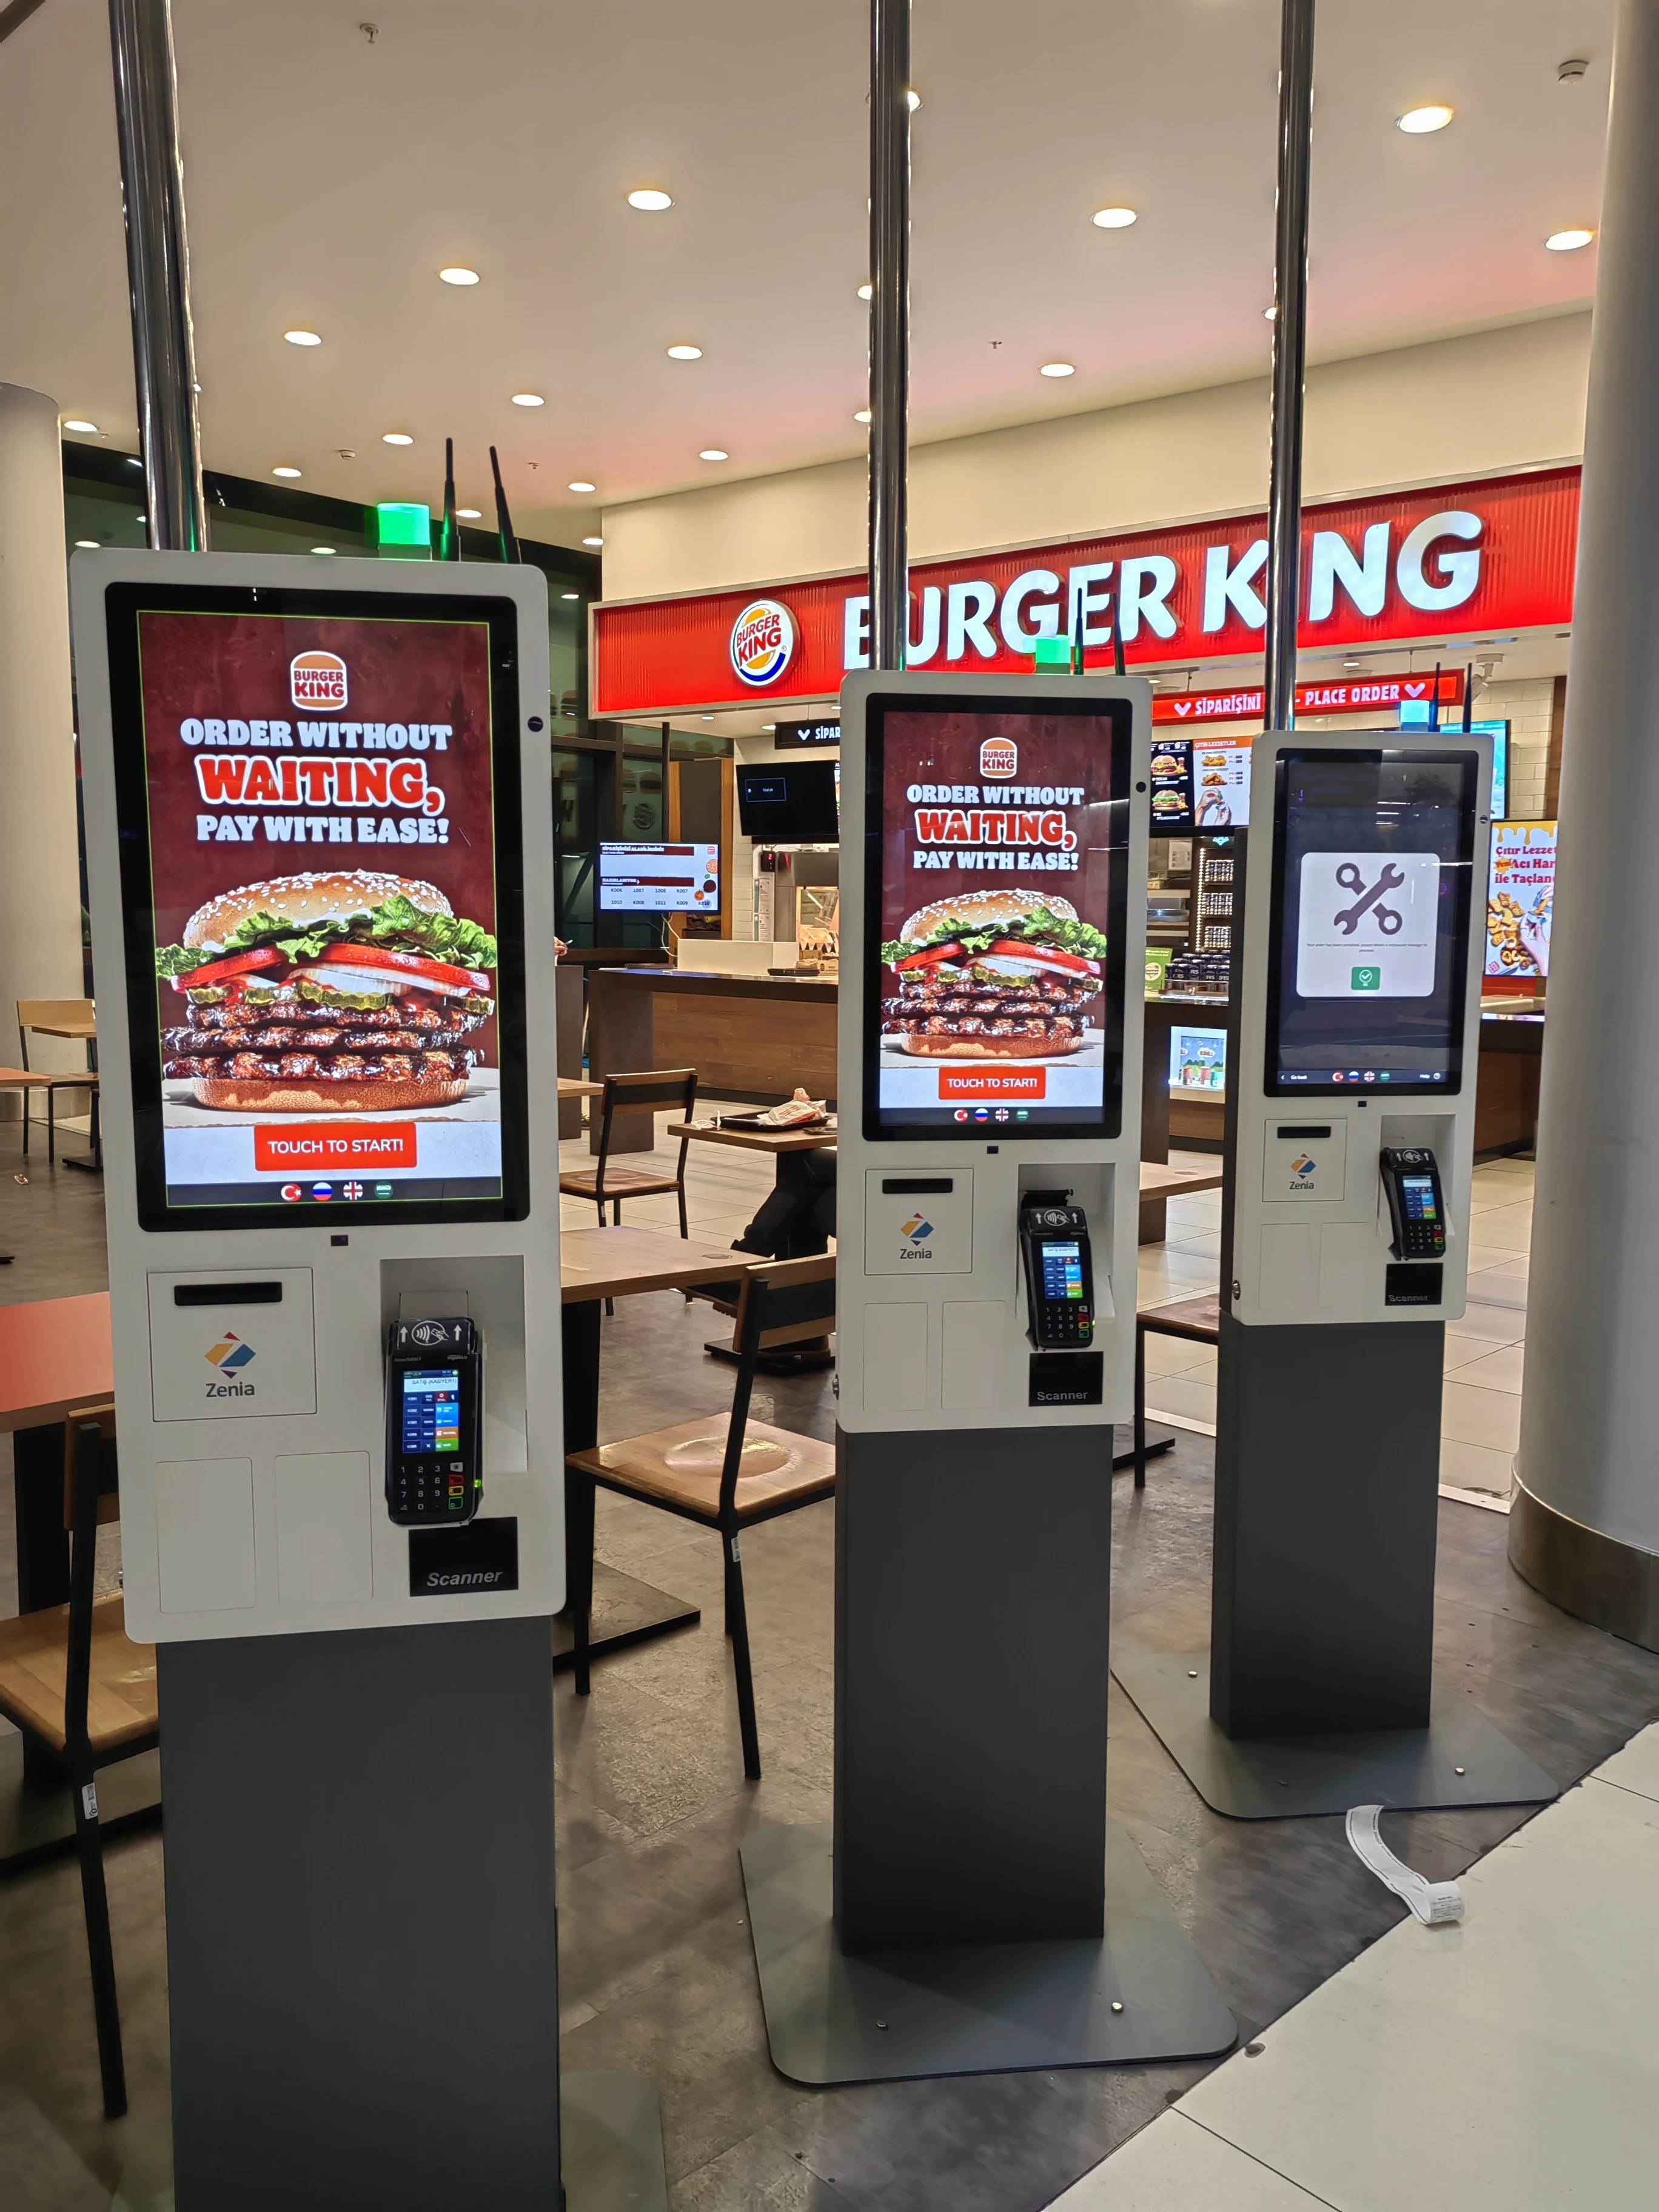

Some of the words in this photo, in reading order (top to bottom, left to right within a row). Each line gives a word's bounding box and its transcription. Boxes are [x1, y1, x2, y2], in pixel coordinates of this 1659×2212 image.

[1203, 511, 1482, 632] KNG
[737, 614, 780, 648] BURGER
[739, 627, 781, 667] KING
[293, 671, 344, 682] BURGER
[294, 682, 344, 698] KING
[1195, 692, 1261, 716] SİPARİŞİNİ
[1305, 688, 1346, 706] PLACE
[1353, 685, 1399, 702] ORDER
[181, 719, 293, 747] ORDER
[298, 721, 452, 750] WITHOUT
[982, 759, 1014, 769] KING
[195, 755, 445, 816] WAITING,
[907, 785, 979, 803] ORDER
[982, 786, 1085, 805] WITHOUT
[196, 815, 260, 841] PAY
[263, 816, 352, 842] WITH
[357, 817, 449, 843] EASE!
[914, 809, 1078, 851] WAITING,
[1496, 846, 1520, 857] Çıtır
[913, 851, 953, 869] PAY
[957, 852, 1014, 870] WITH
[1017, 853, 1079, 871] EASE!
[1512, 859, 1530, 868] Acı
[1495, 873, 1509, 883] ile
[1512, 873, 1555, 886] Taçlan
[947, 1079, 984, 1087] TOUCH
[985, 1078, 1000, 1087] TO
[1002, 1078, 1037, 1087] START!
[267, 1140, 323, 1154] TOUCH
[327, 1140, 347, 1152] TO
[352, 1139, 403, 1152] START!
[1289, 1181, 1314, 1190] Zenia
[900, 1248, 933, 1259] Zenia
[1389, 1294, 1428, 1302] Scanner
[206, 1382, 255, 1398] Zenia
[1036, 1391, 1088, 1401] Scanner
[426, 1570, 502, 1587] Scanner
